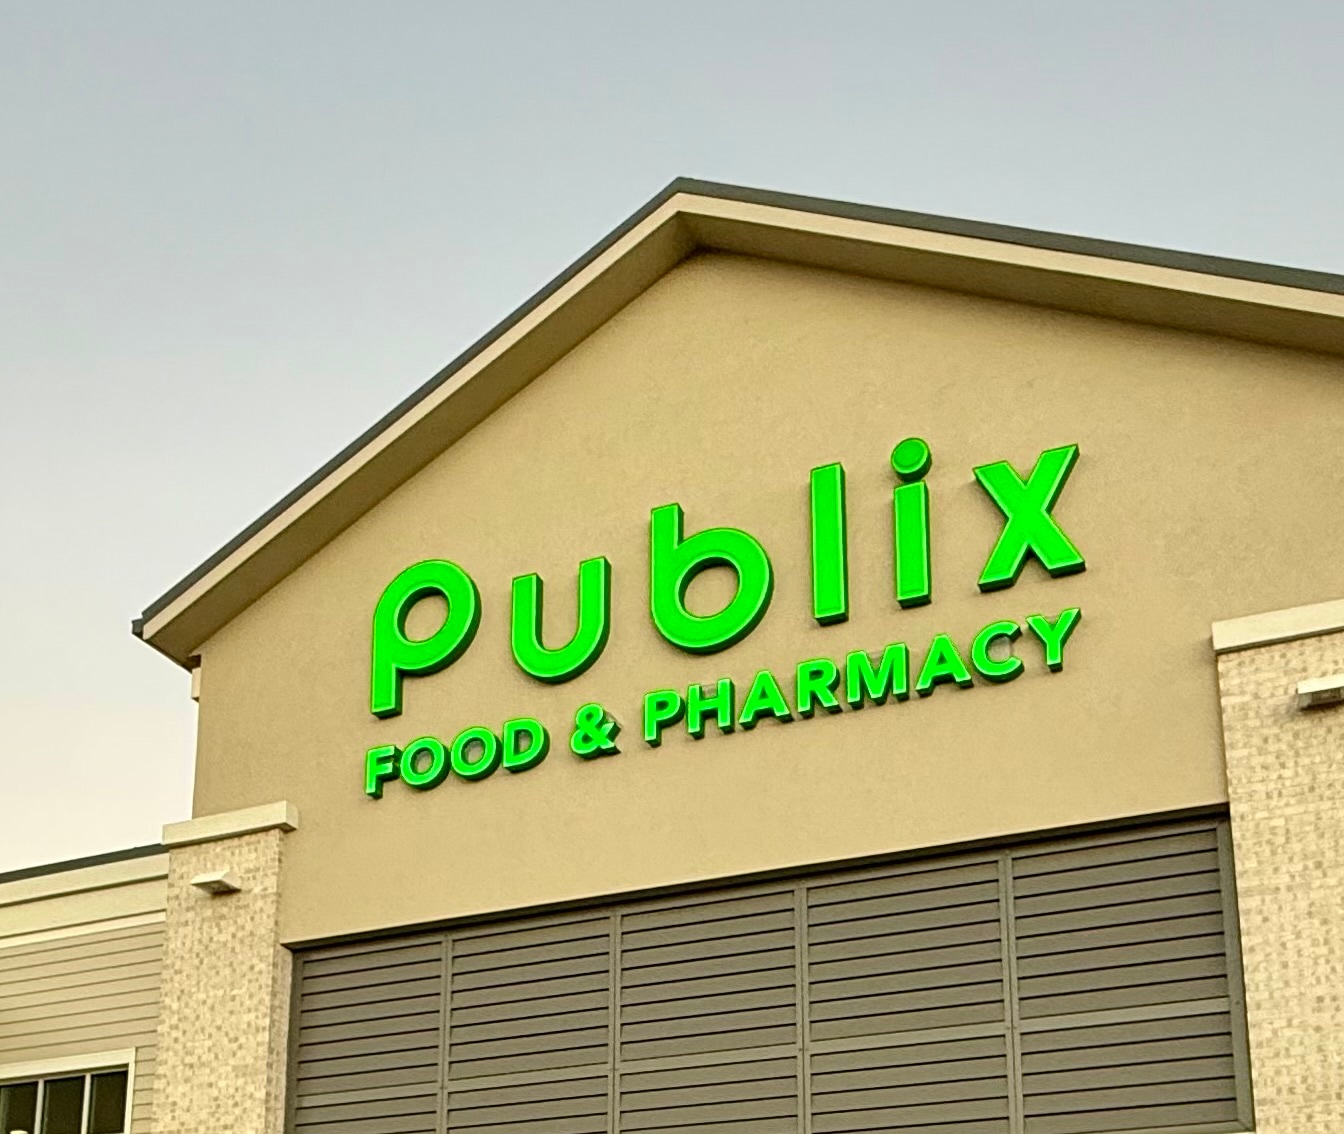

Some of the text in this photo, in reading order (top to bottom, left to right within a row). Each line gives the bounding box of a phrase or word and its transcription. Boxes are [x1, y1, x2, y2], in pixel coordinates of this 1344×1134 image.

[370, 436, 1087, 718] Publix
[366, 608, 1081, 799] FOOD & PHARMACY
